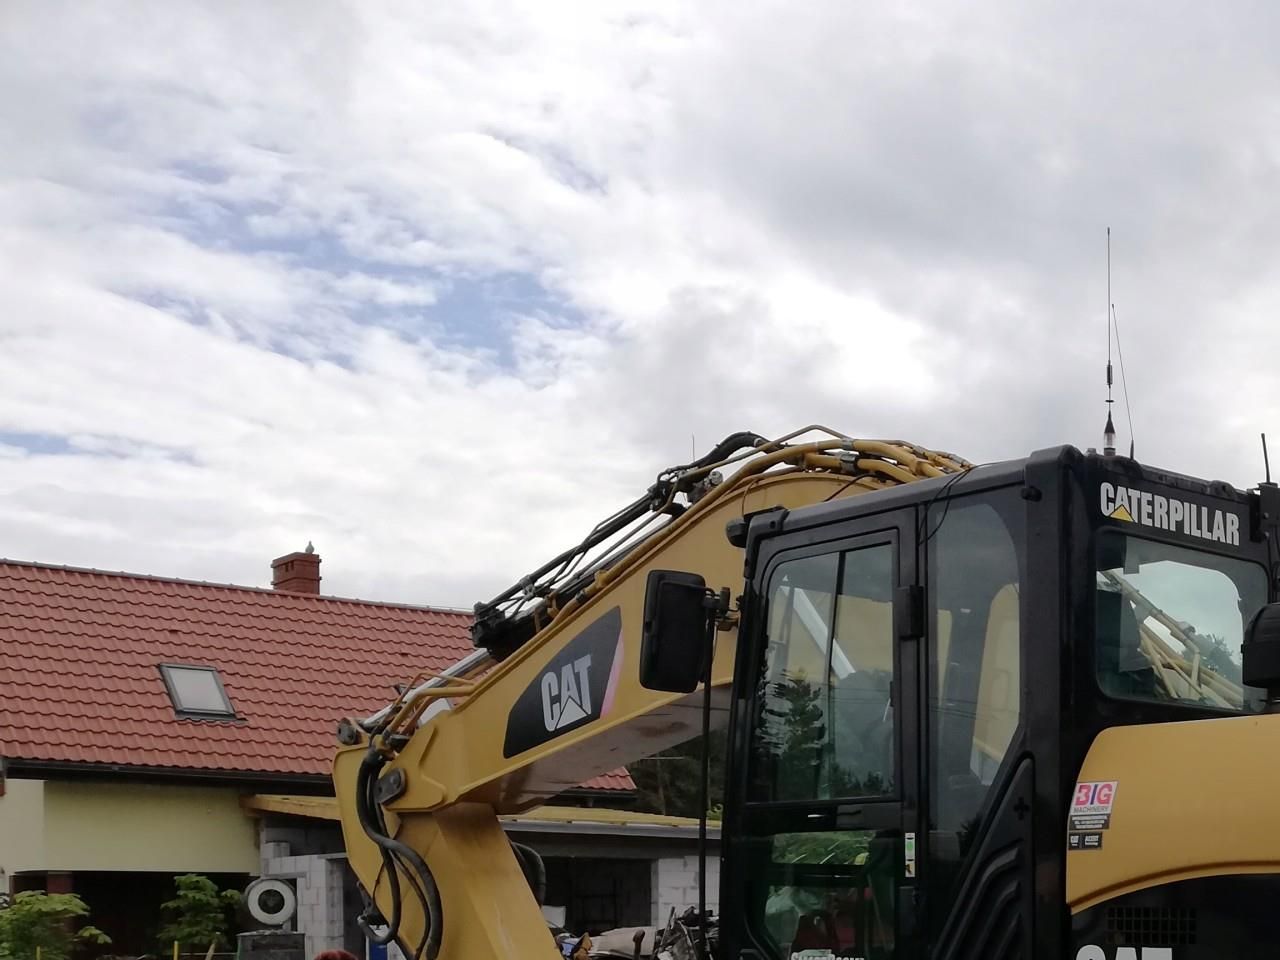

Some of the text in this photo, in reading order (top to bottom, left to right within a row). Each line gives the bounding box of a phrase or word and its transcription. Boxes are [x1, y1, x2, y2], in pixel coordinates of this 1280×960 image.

[1100, 482, 1240, 546] CATERPILLAR
[541, 654, 592, 732] CAT
[1075, 783, 1113, 806] BIG
